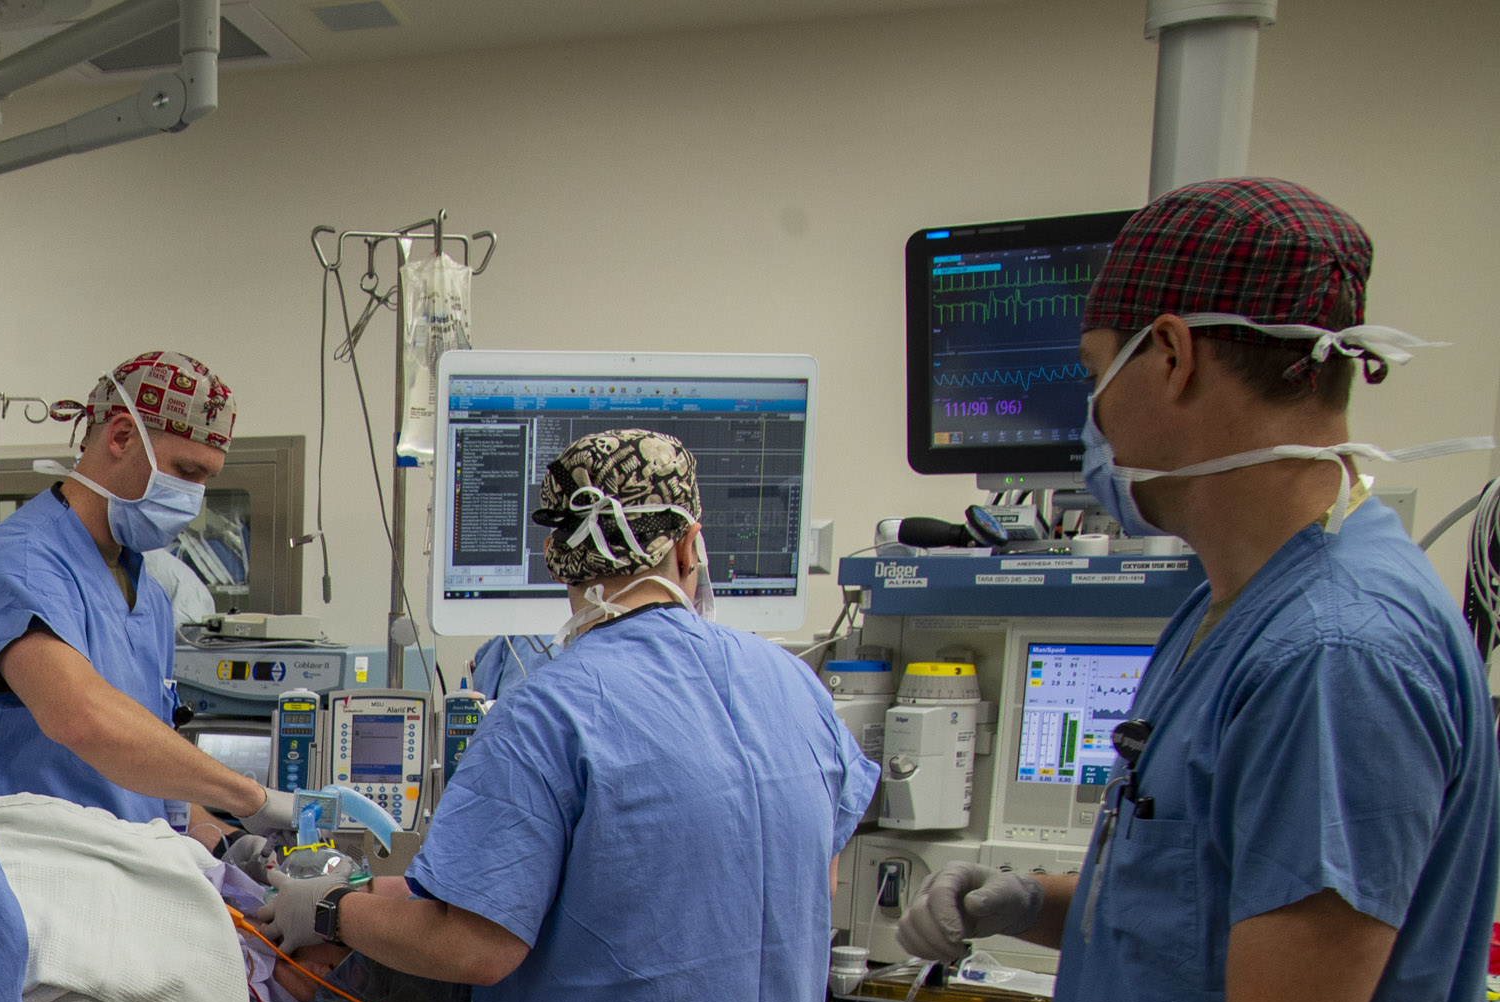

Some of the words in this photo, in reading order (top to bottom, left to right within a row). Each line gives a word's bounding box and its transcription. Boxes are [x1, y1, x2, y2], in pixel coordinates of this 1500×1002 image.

[148, 371, 166, 381] STATE
[151, 366, 167, 376] OHIO
[168, 397, 186, 408] OHIO
[945, 401, 988, 416] 111/90
[996, 400, 1022, 415] (96)
[166, 404, 185, 415] STATE
[875, 561, 919, 580] Dräger
[293, 661, 323, 669] Coblator
